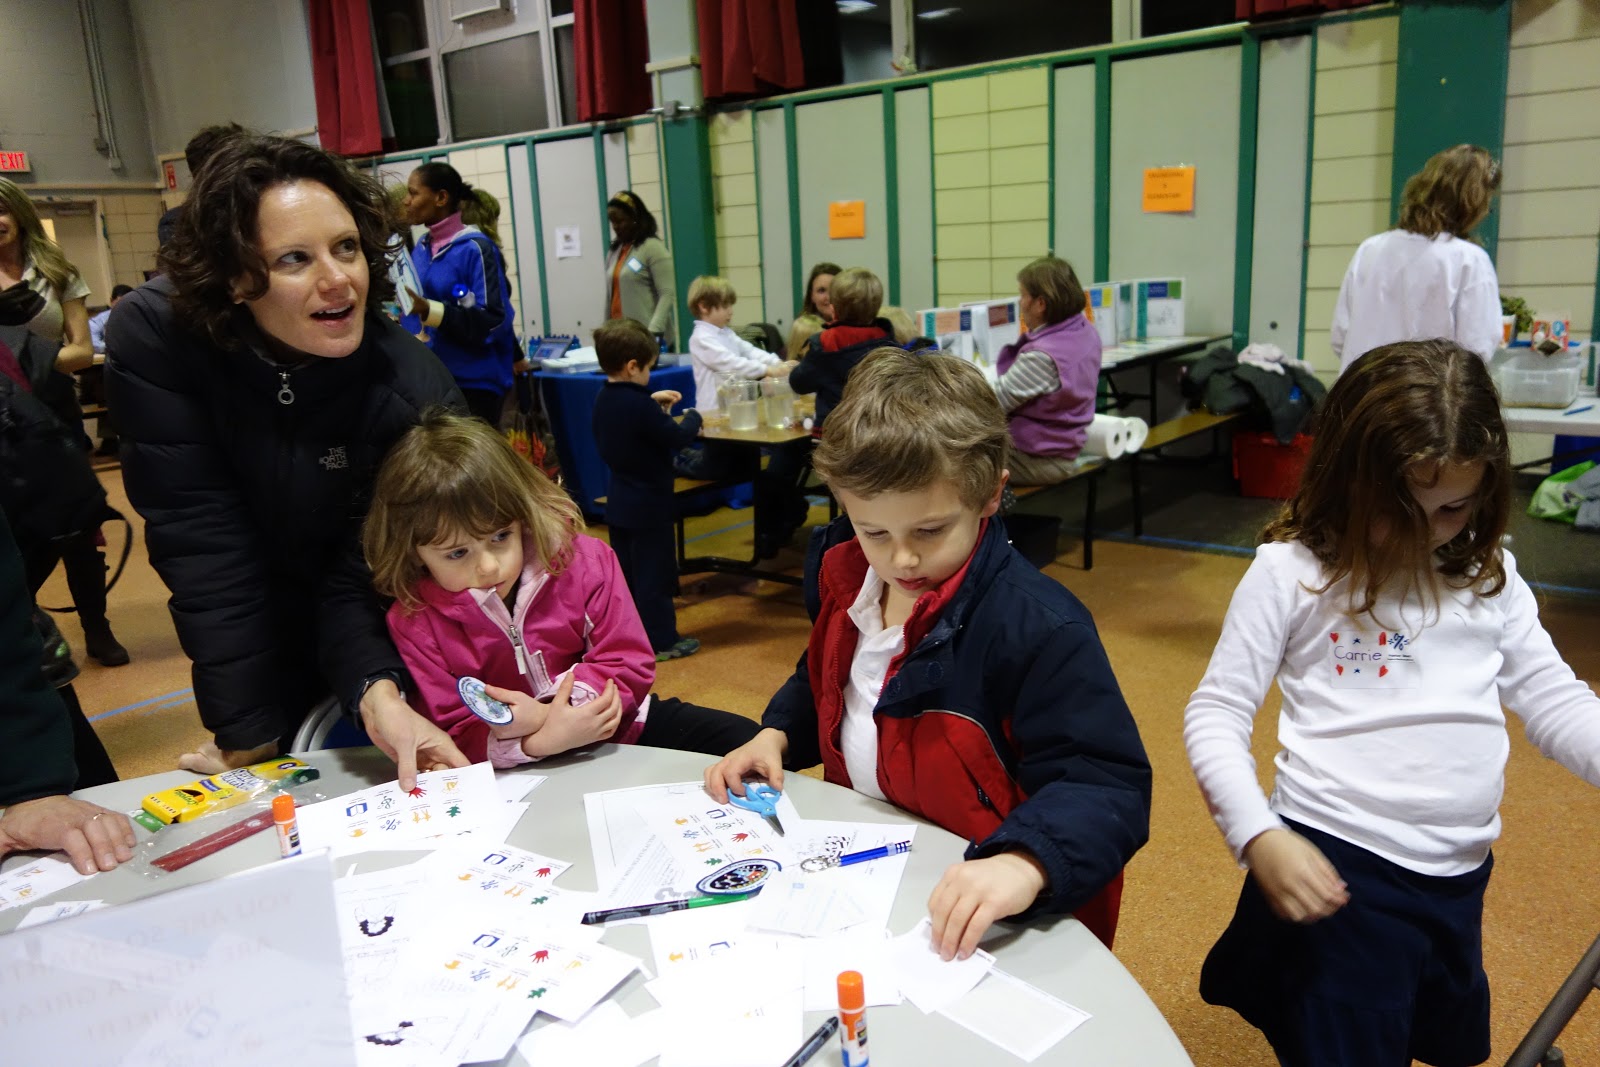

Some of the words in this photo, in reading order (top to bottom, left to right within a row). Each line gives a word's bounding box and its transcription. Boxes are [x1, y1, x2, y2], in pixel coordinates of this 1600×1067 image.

[0, 152, 26, 170] EXIT
[327, 446, 346, 455] THE
[319, 453, 347, 464] NORTH
[326, 460, 348, 470] FACE
[1333, 645, 1382, 661] Carrie
